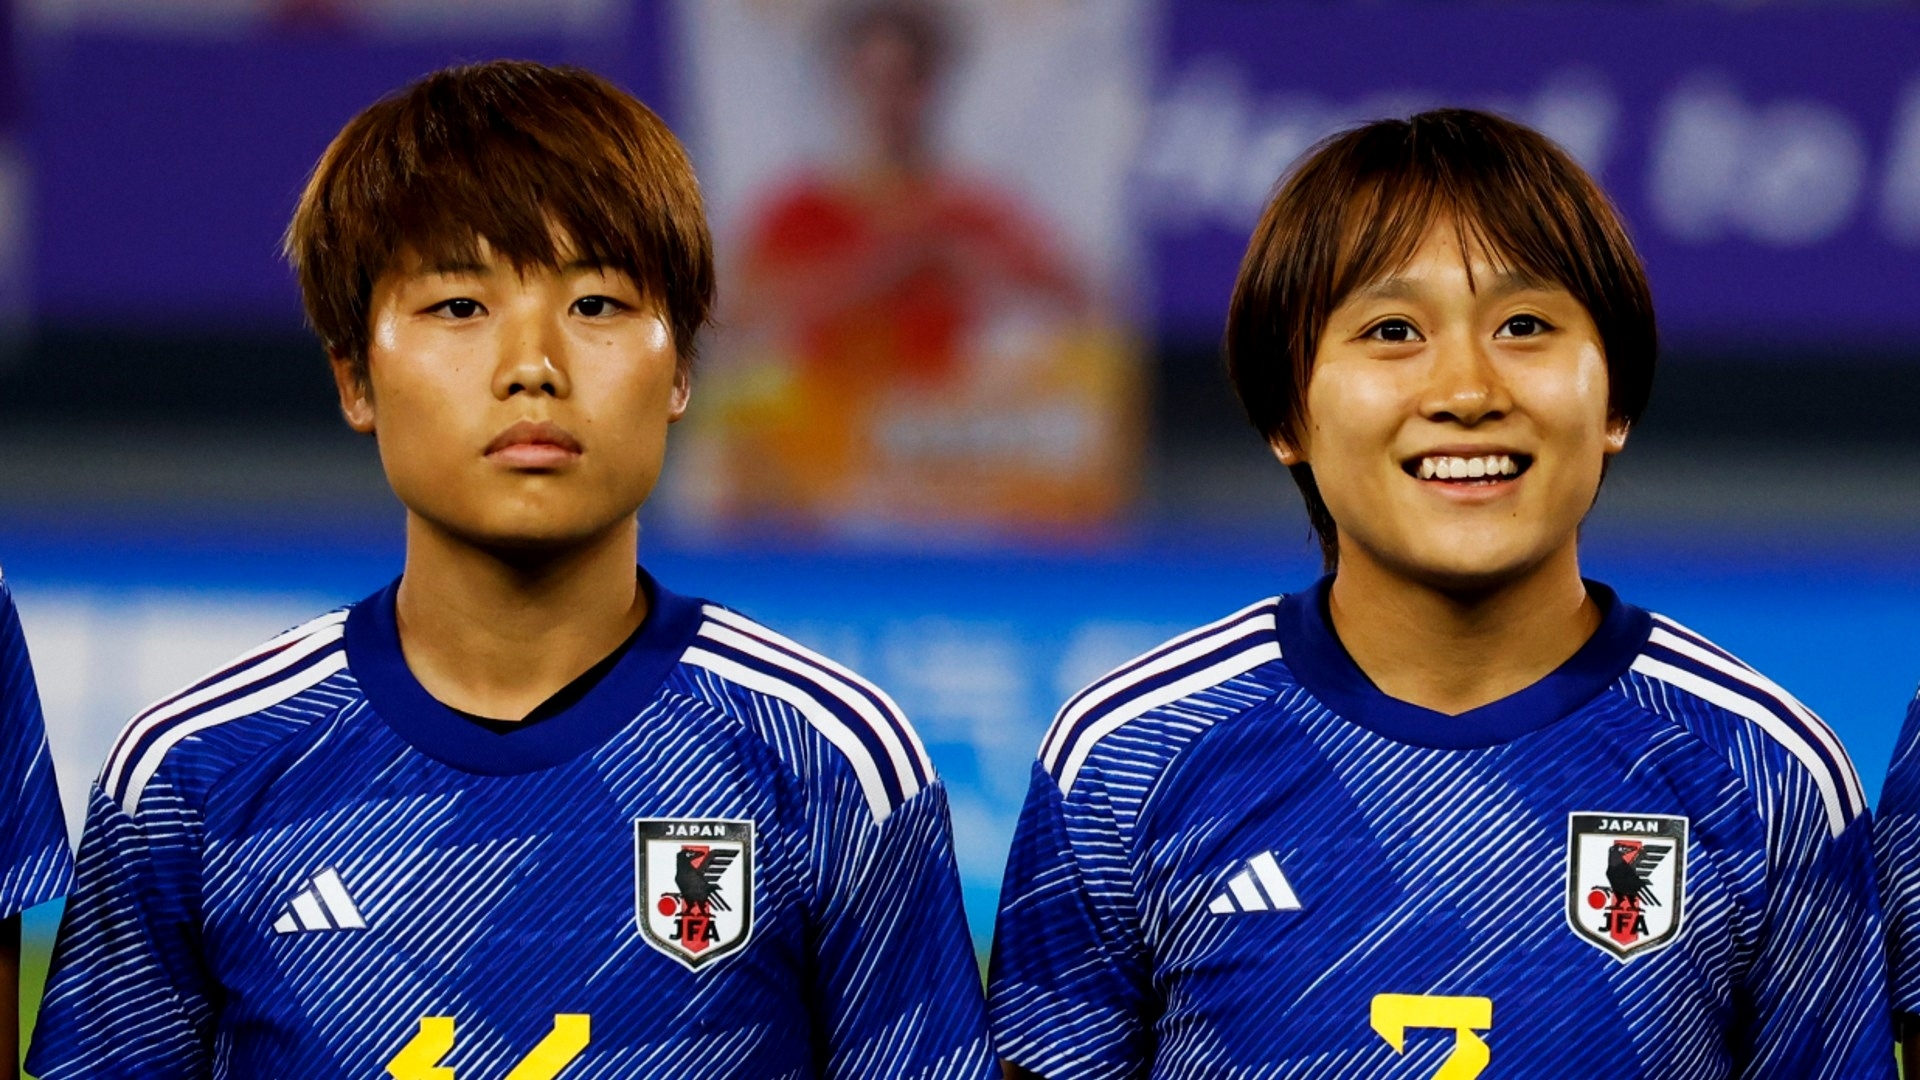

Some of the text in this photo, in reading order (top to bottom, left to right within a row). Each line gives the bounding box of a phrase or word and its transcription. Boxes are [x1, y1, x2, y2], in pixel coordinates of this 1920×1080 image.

[665, 824, 726, 836] JAPAN
[1598, 819, 1659, 832] JAPAN
[668, 919, 721, 942] JFA
[1598, 912, 1650, 936] JFA
